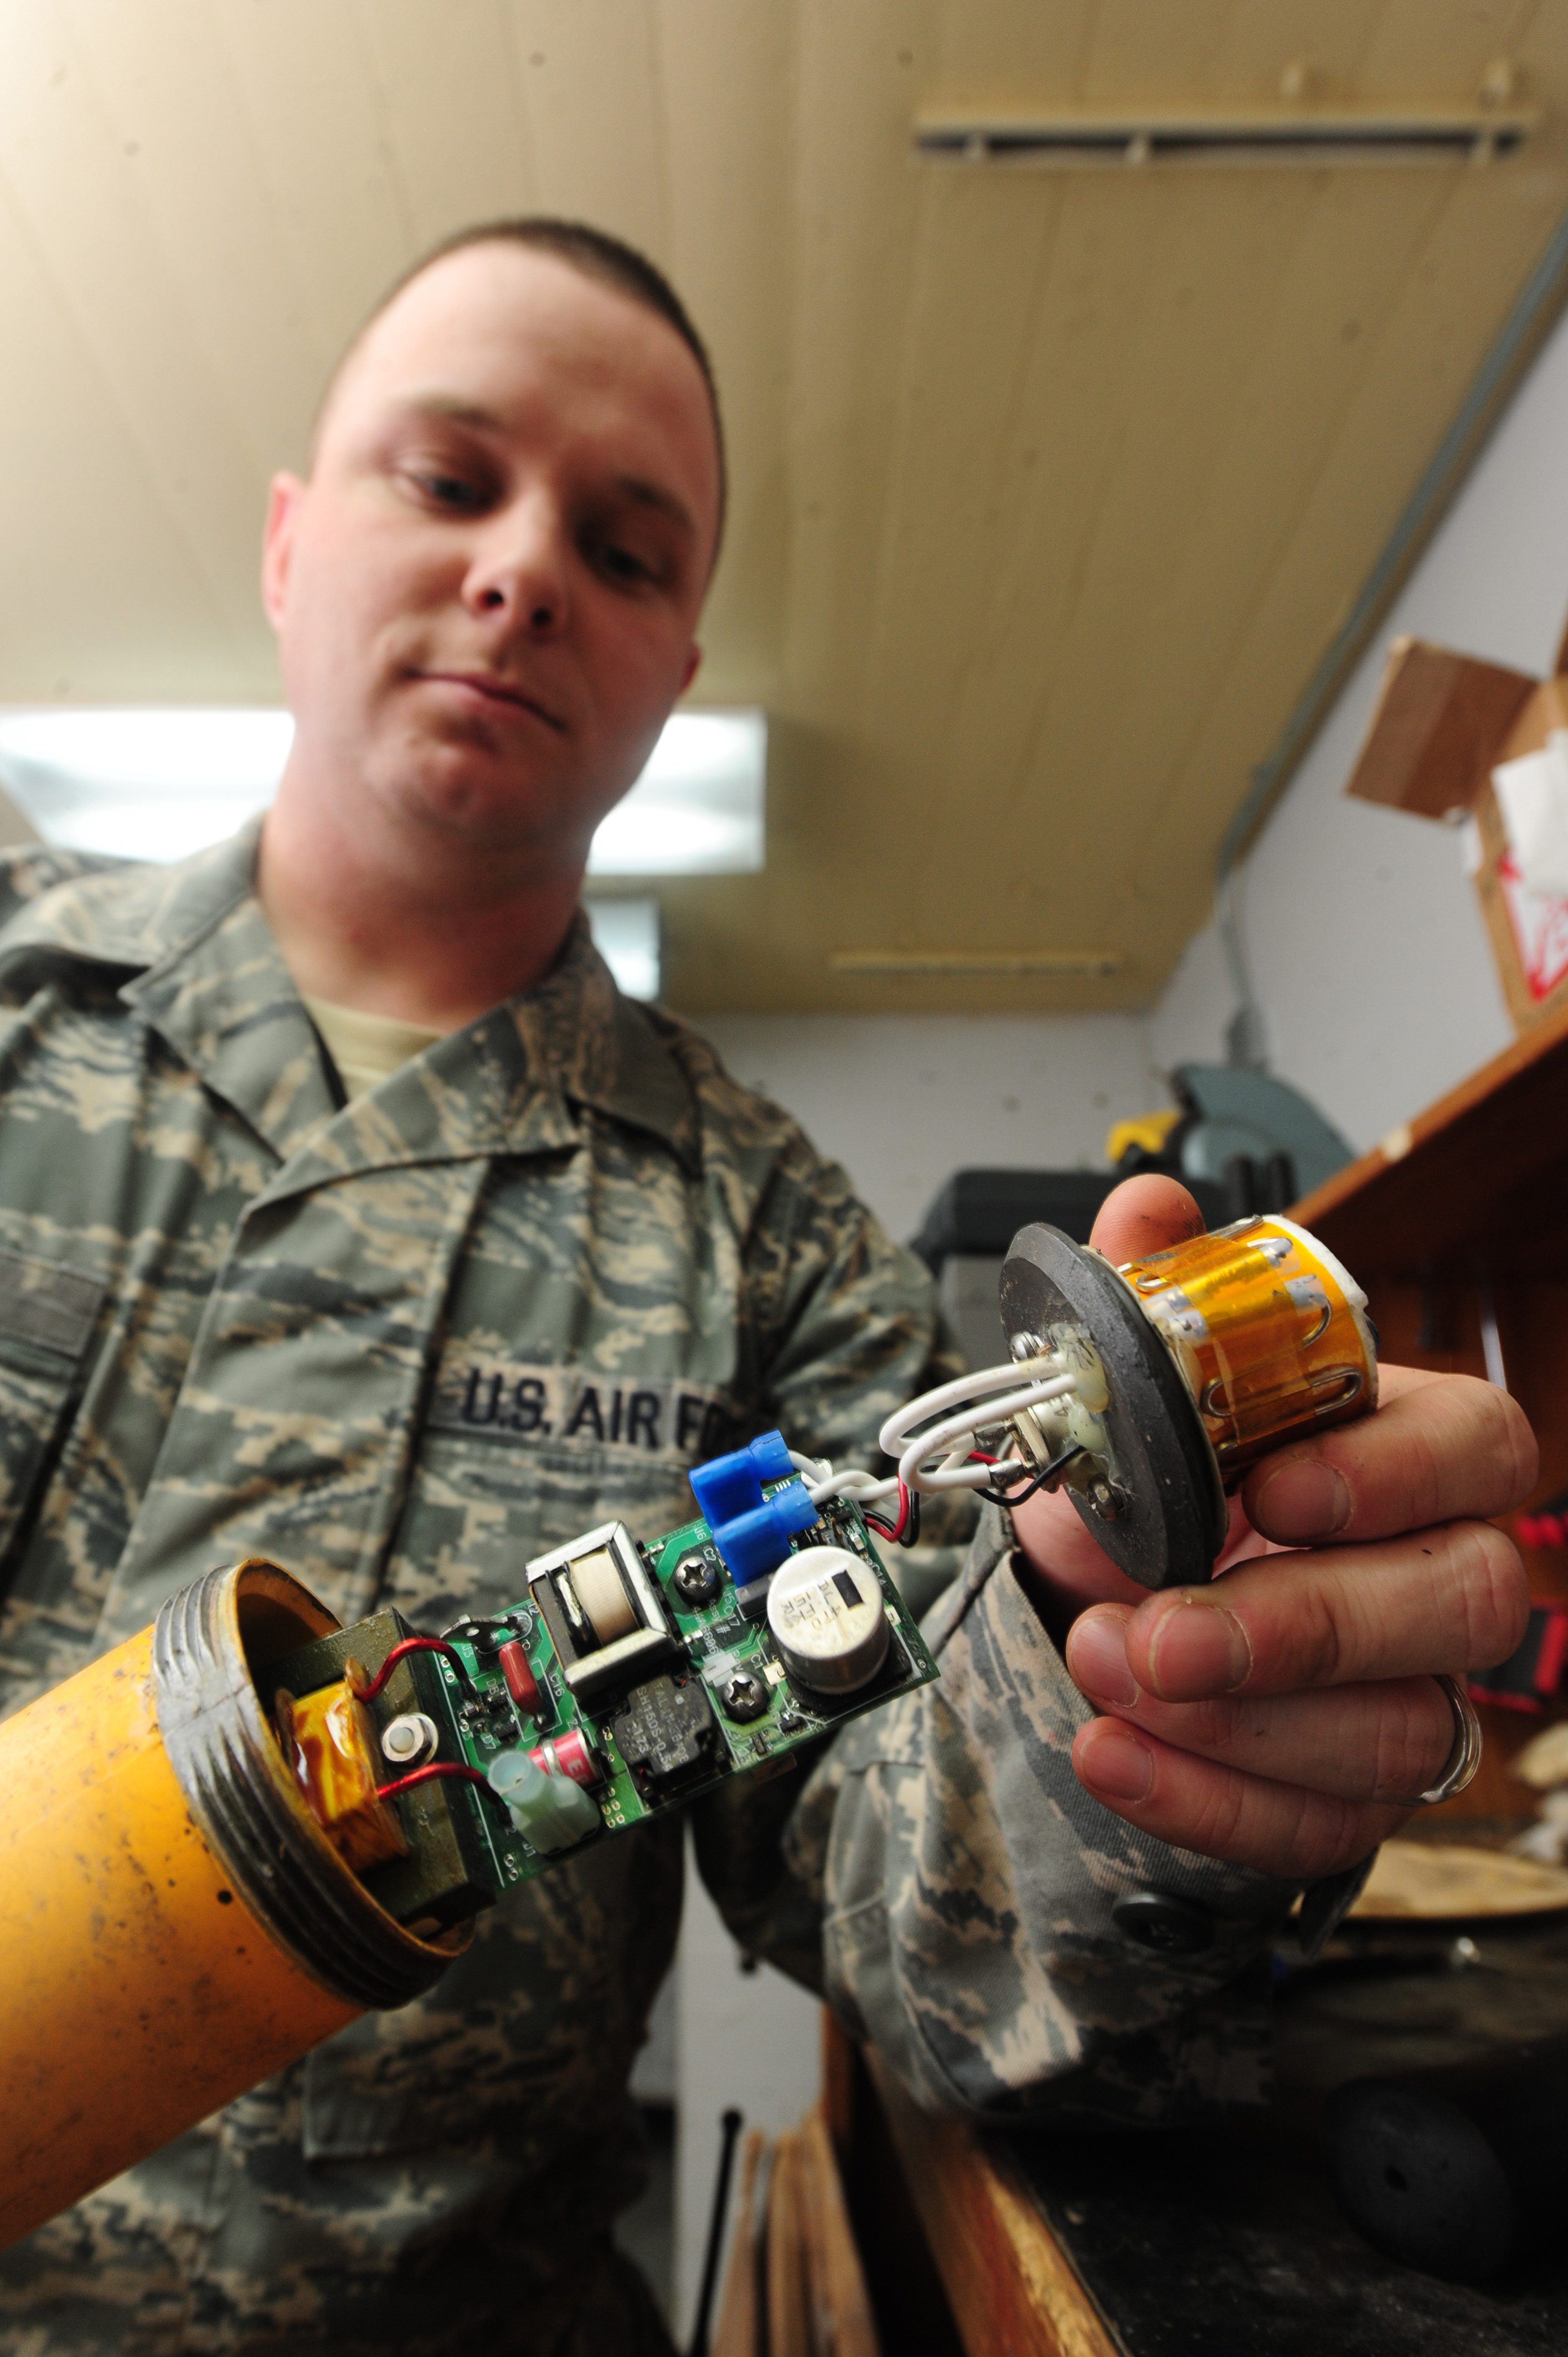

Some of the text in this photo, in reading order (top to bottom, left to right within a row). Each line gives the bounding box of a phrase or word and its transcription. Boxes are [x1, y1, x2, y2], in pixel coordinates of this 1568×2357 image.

[462, 1366, 551, 1435] U.S.
[565, 1386, 661, 1450] AIR
[694, 1525, 706, 1541] J6
[721, 1589, 734, 1604] J5
[704, 1597, 724, 1624] Assy
[723, 1604, 741, 1629] C17
[460, 1643, 475, 1660] J3
[749, 1653, 765, 1670] C1
[548, 1671, 566, 1698] C16
[481, 1734, 498, 1752] D7
